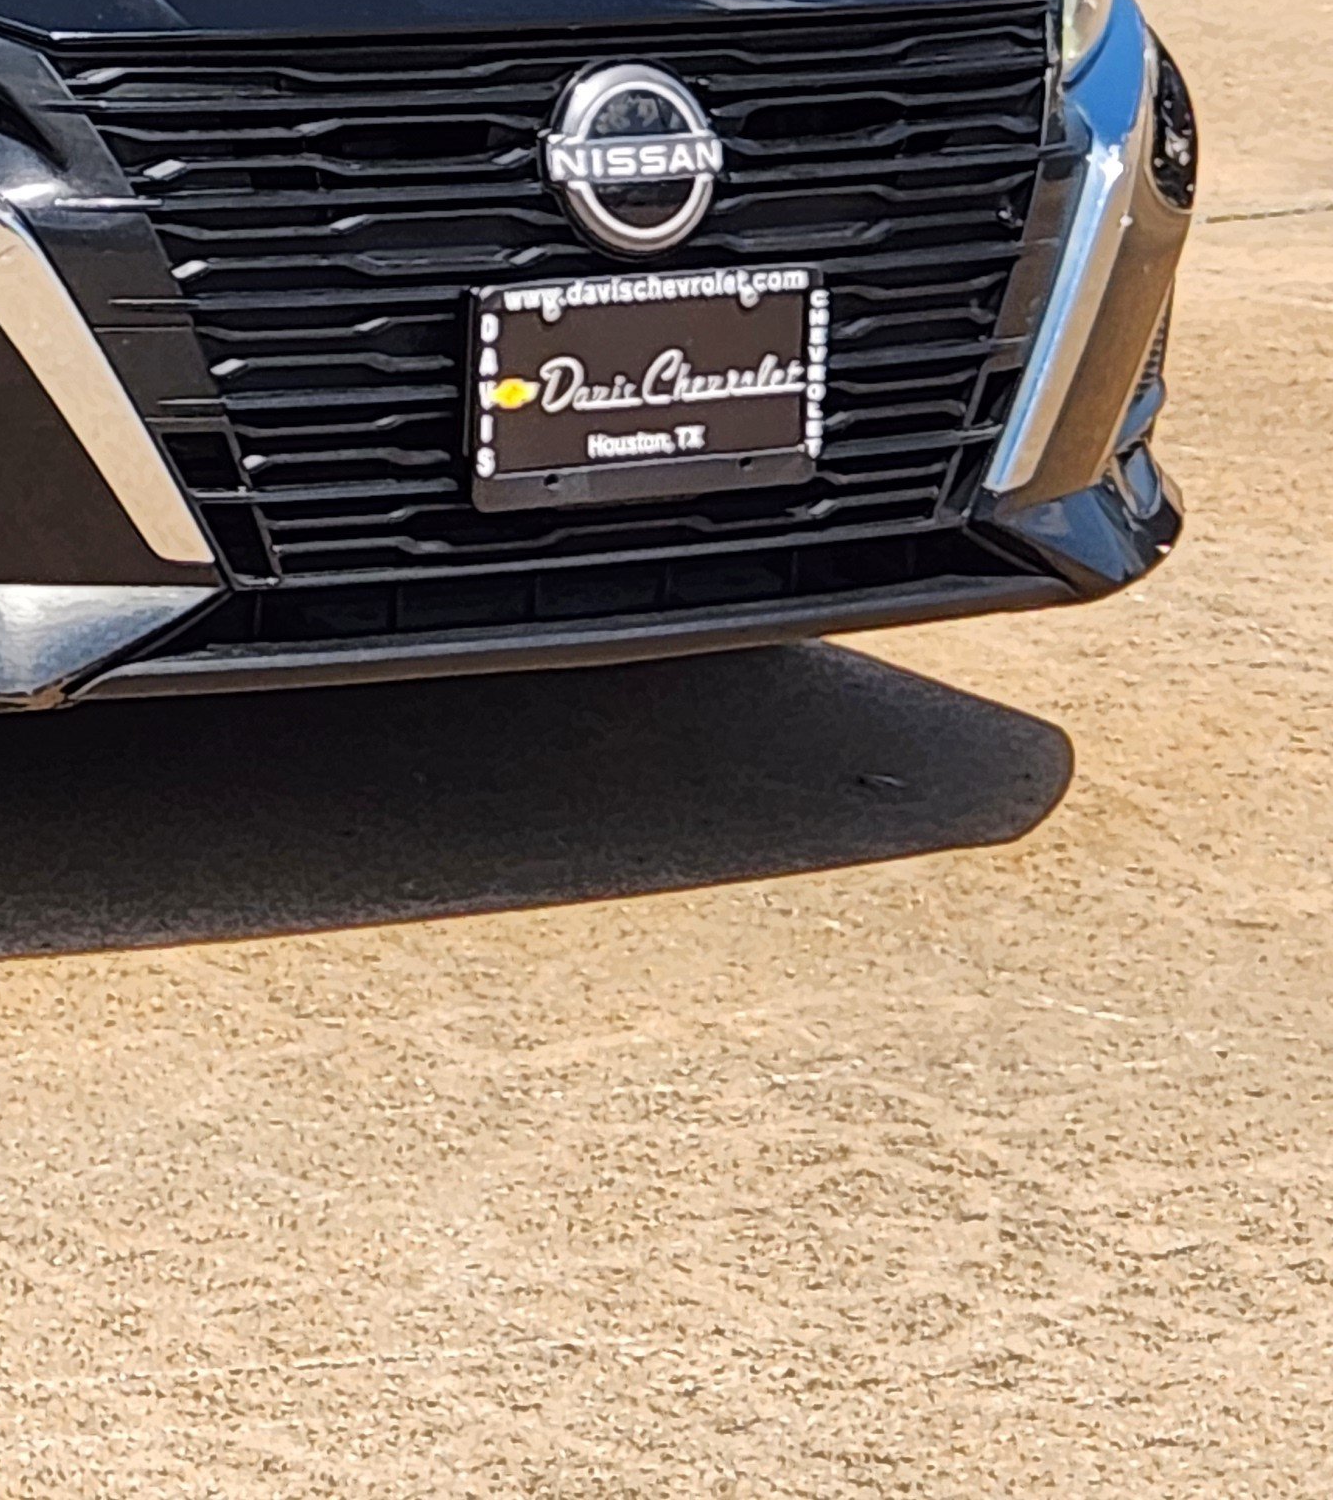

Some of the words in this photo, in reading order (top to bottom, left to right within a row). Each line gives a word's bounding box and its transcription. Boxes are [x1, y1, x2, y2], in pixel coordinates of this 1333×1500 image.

[550, 138, 724, 181] NISSAN
[504, 269, 809, 312] www.davischevrolet.com
[476, 313, 499, 478] DAVIS
[539, 356, 643, 413] Davis
[642, 349, 806, 405] Chevrolet
[804, 289, 831, 460] CHEVROLET
[587, 431, 676, 459] Houston,
[674, 424, 706, 451] TX
